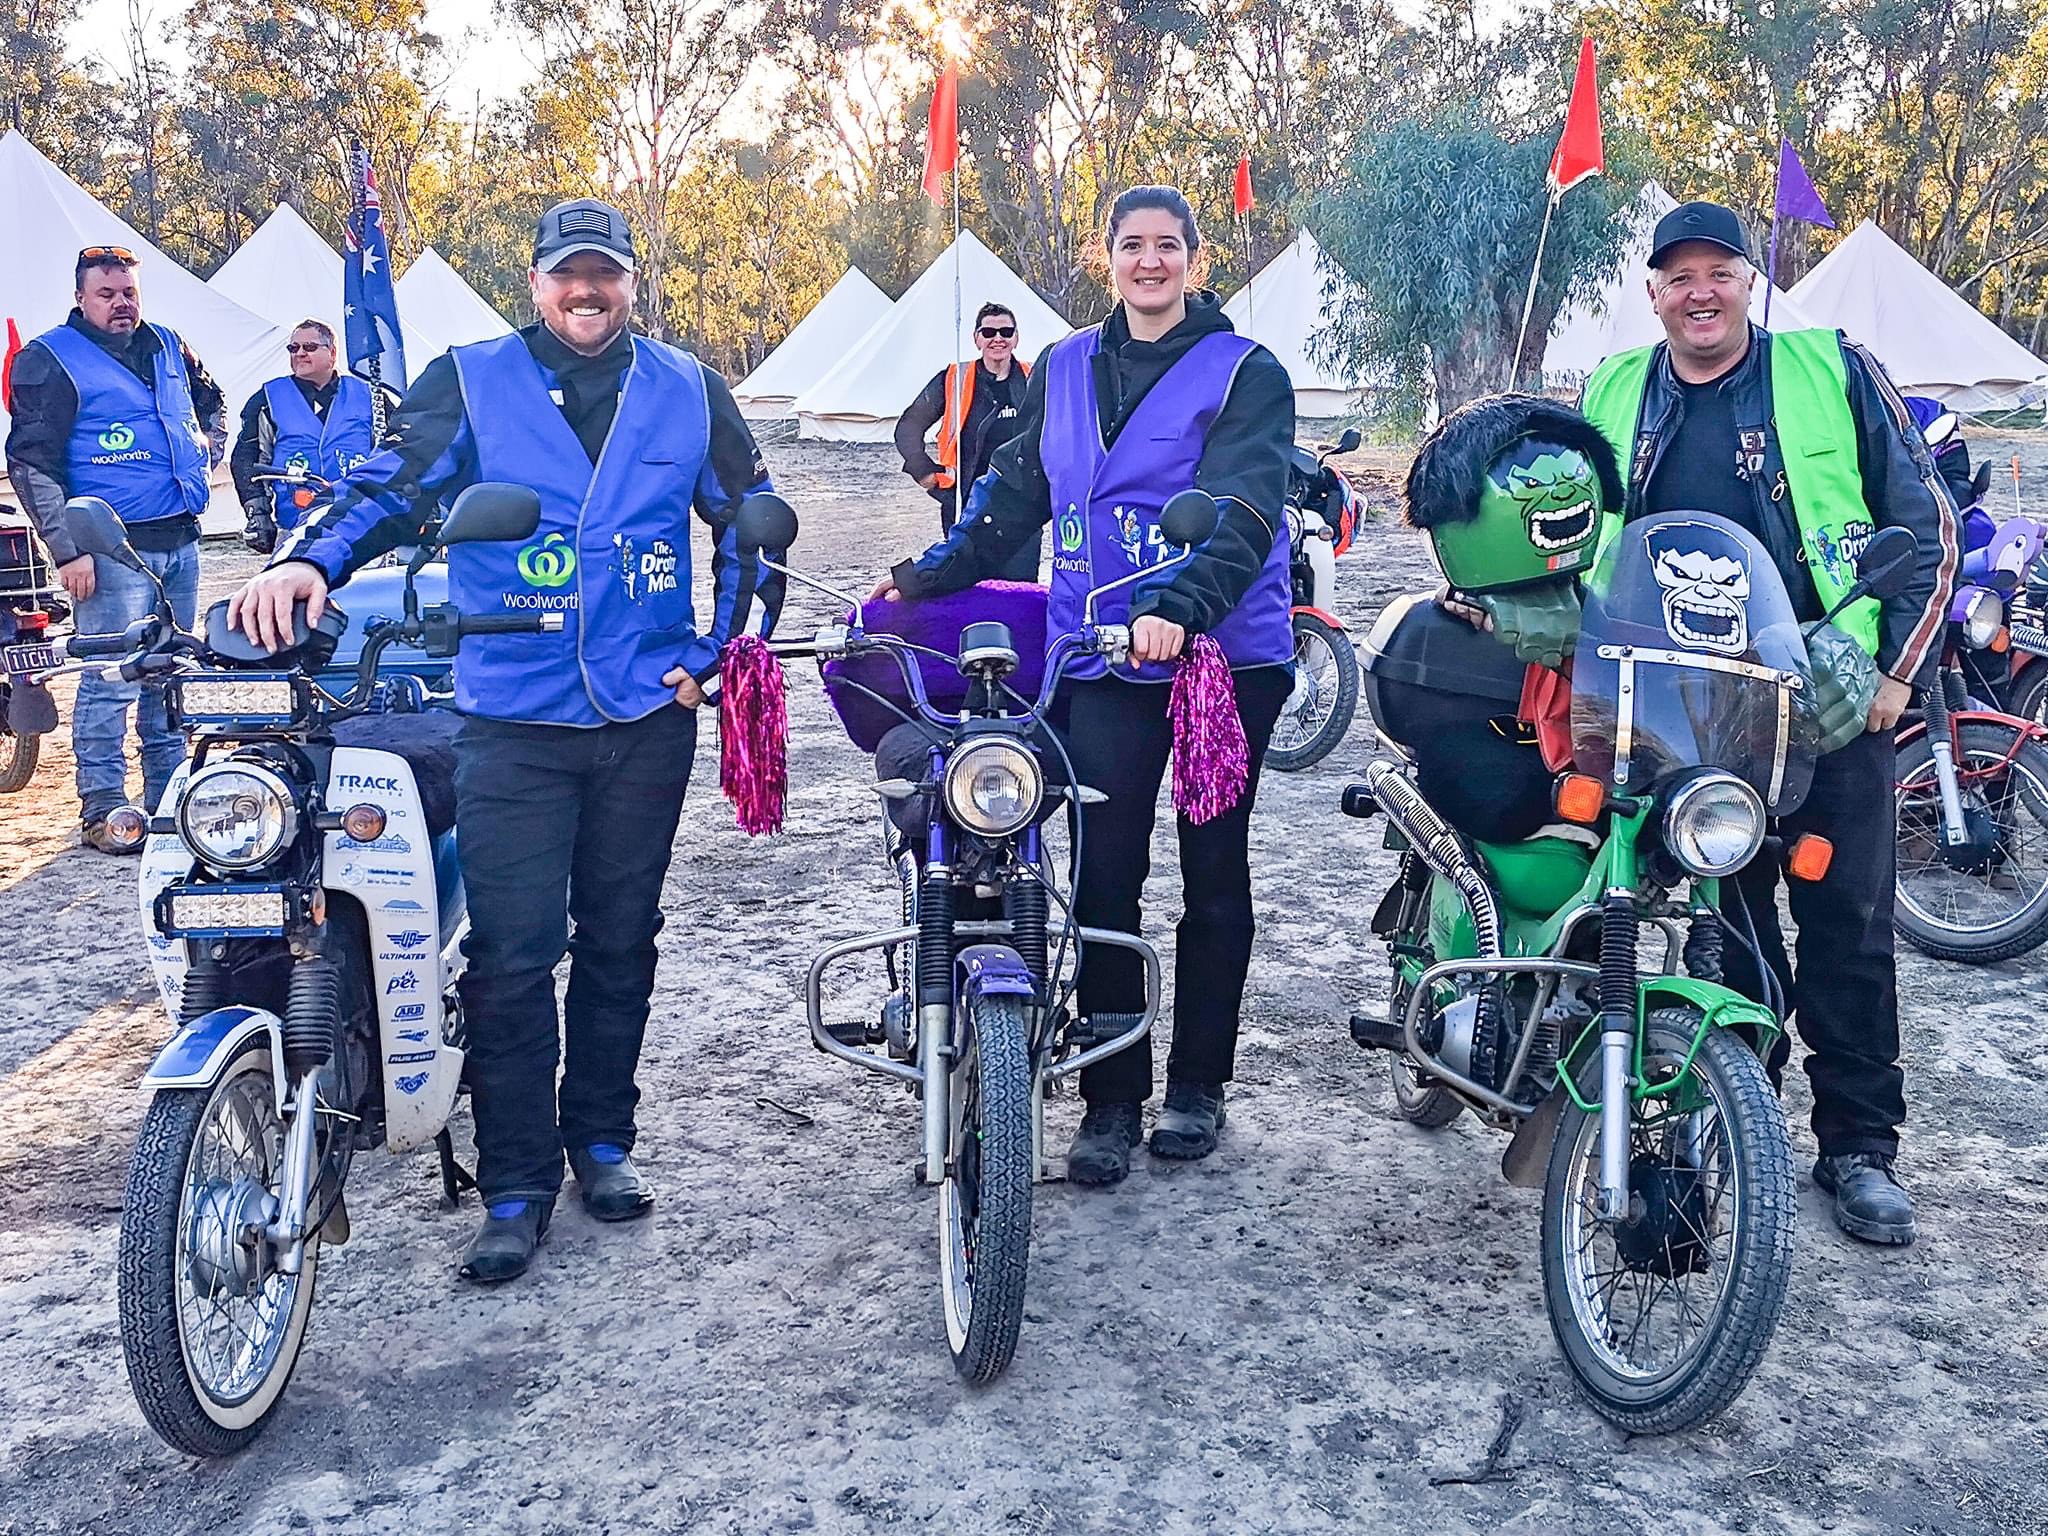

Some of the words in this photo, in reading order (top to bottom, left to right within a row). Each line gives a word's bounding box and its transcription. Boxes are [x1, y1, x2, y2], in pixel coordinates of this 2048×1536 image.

[1845, 522, 1867, 538] The
[653, 541, 669, 555] The
[647, 572, 678, 593] Man
